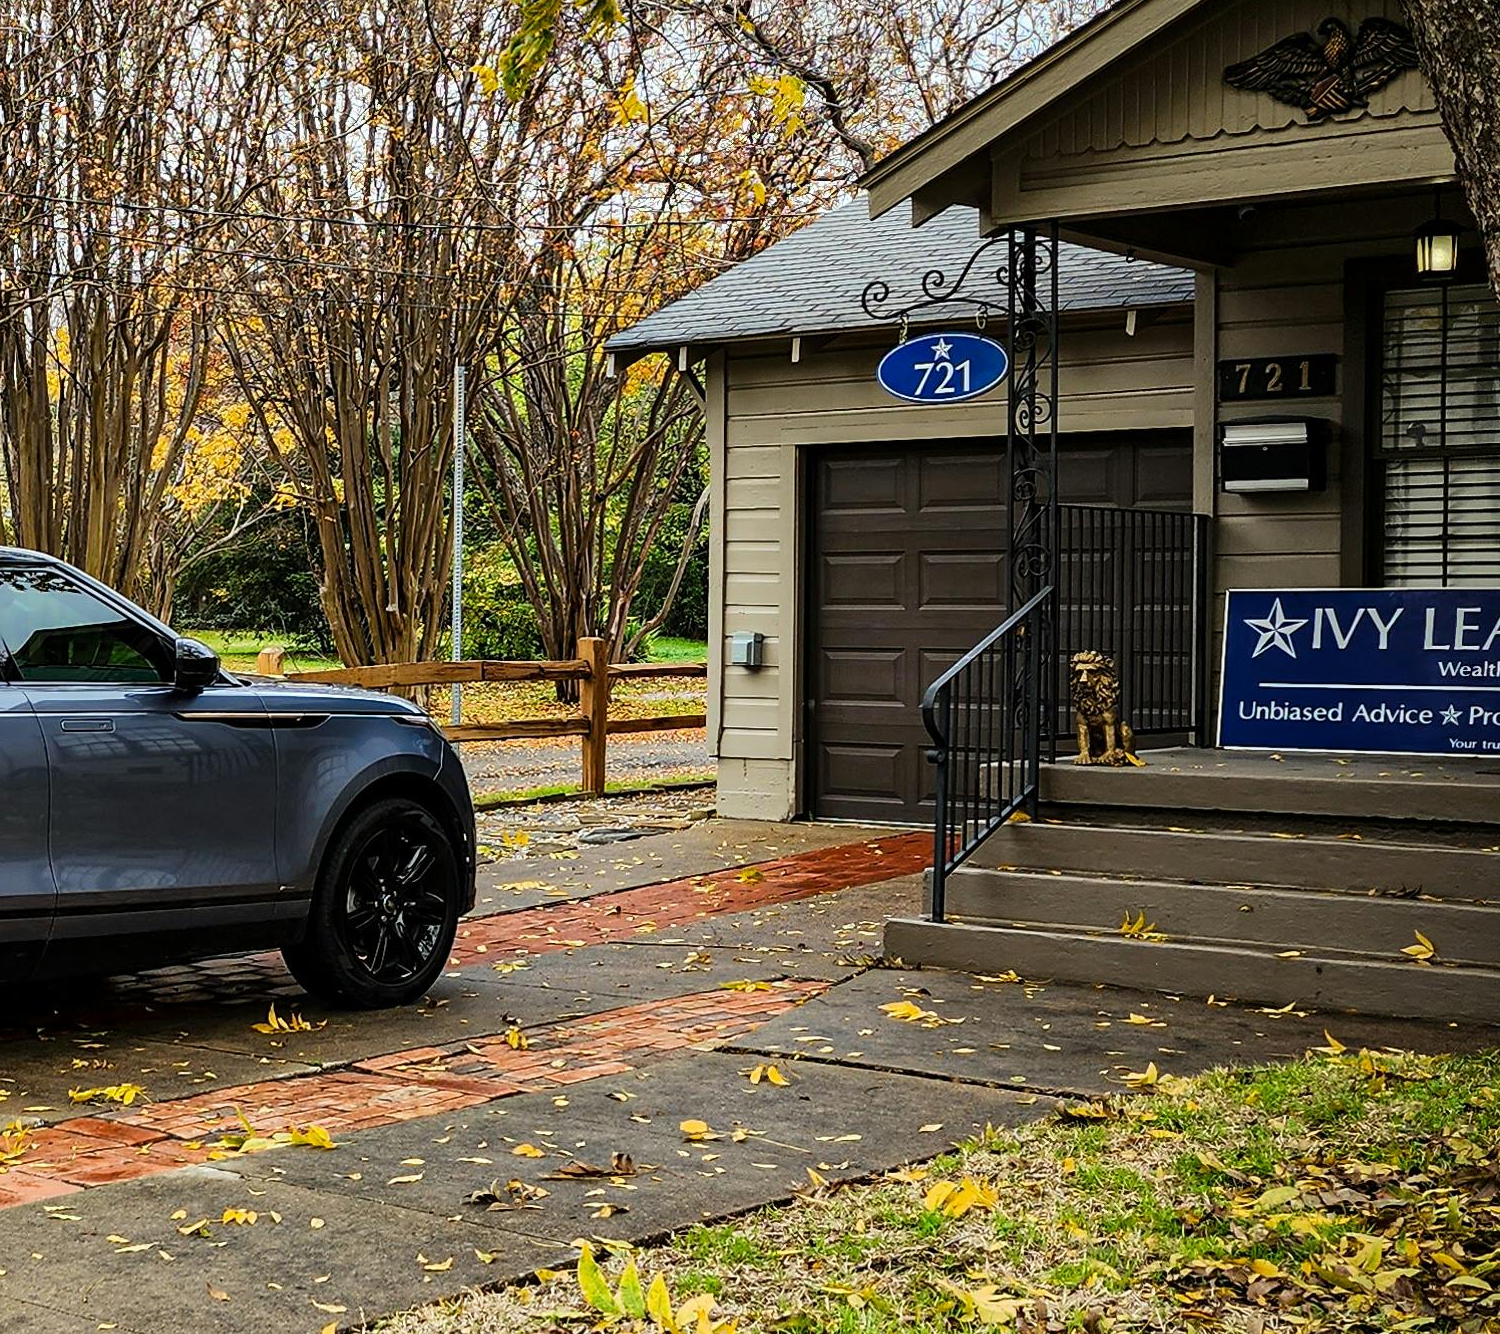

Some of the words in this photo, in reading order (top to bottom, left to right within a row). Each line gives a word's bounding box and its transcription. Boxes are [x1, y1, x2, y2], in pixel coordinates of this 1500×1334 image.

[914, 359, 970, 396] 721
[1235, 361, 1312, 393] 721
[1311, 607, 1404, 650] IVY
[1238, 700, 1343, 722] Unbiased
[1352, 703, 1433, 725] Advice
[1449, 737, 1477, 749] Your
